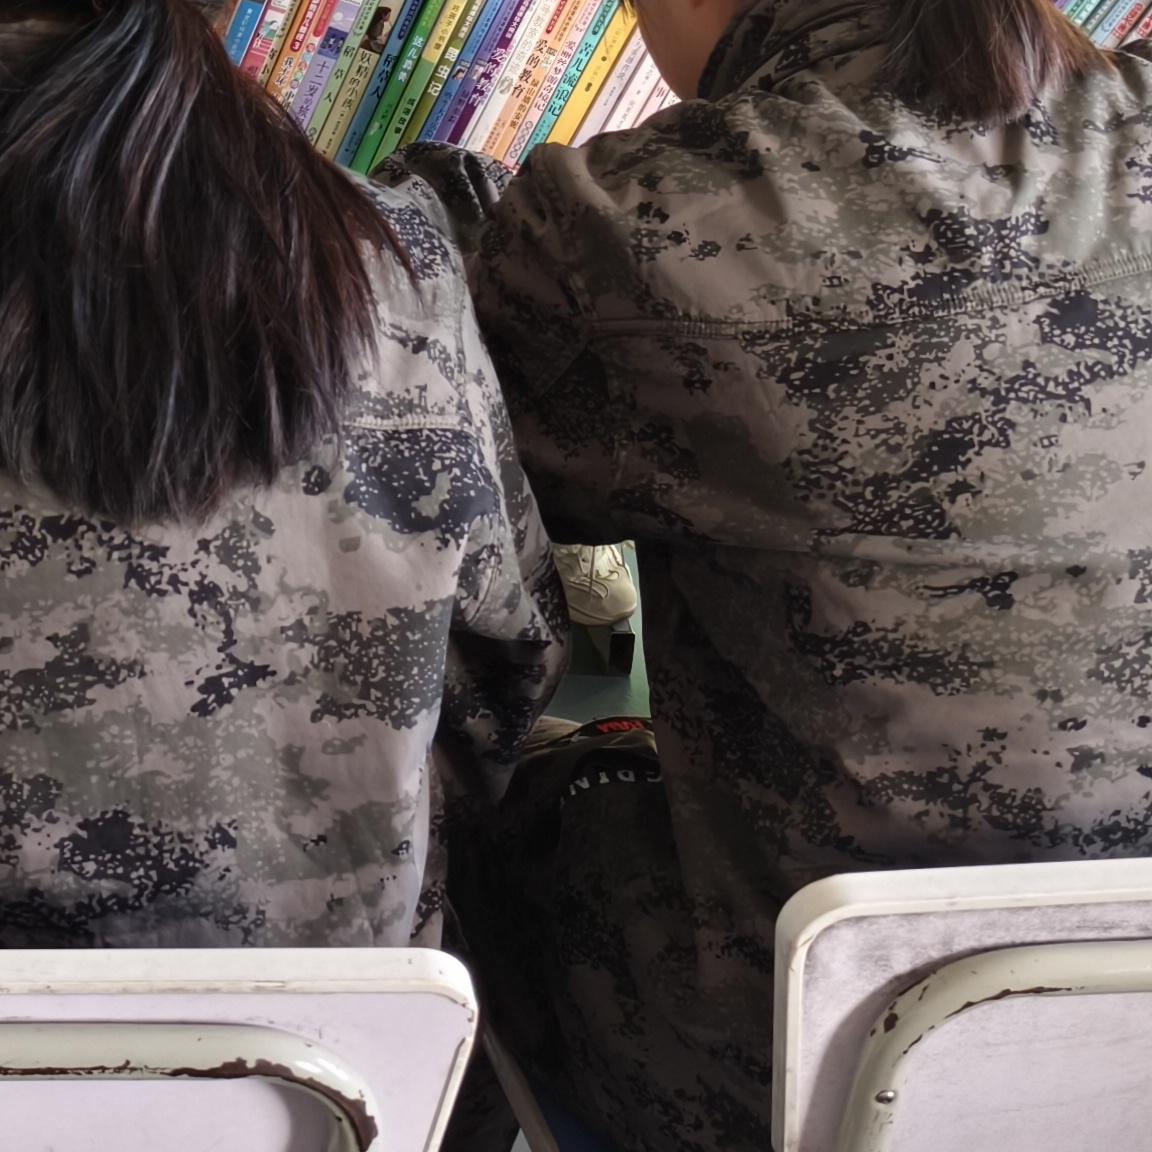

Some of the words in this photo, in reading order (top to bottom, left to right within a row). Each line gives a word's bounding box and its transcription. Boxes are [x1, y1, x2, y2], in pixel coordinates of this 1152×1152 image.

[324, 45, 355, 103] 稻草人
[427, 46, 460, 97] 昆虫记
[468, 47, 508, 106] 爱的教育
[512, 39, 548, 98] 爱的教育
[549, 42, 593, 117] 苦儿流浪记
[510, 78, 539, 130] 绿山墙的安妮
